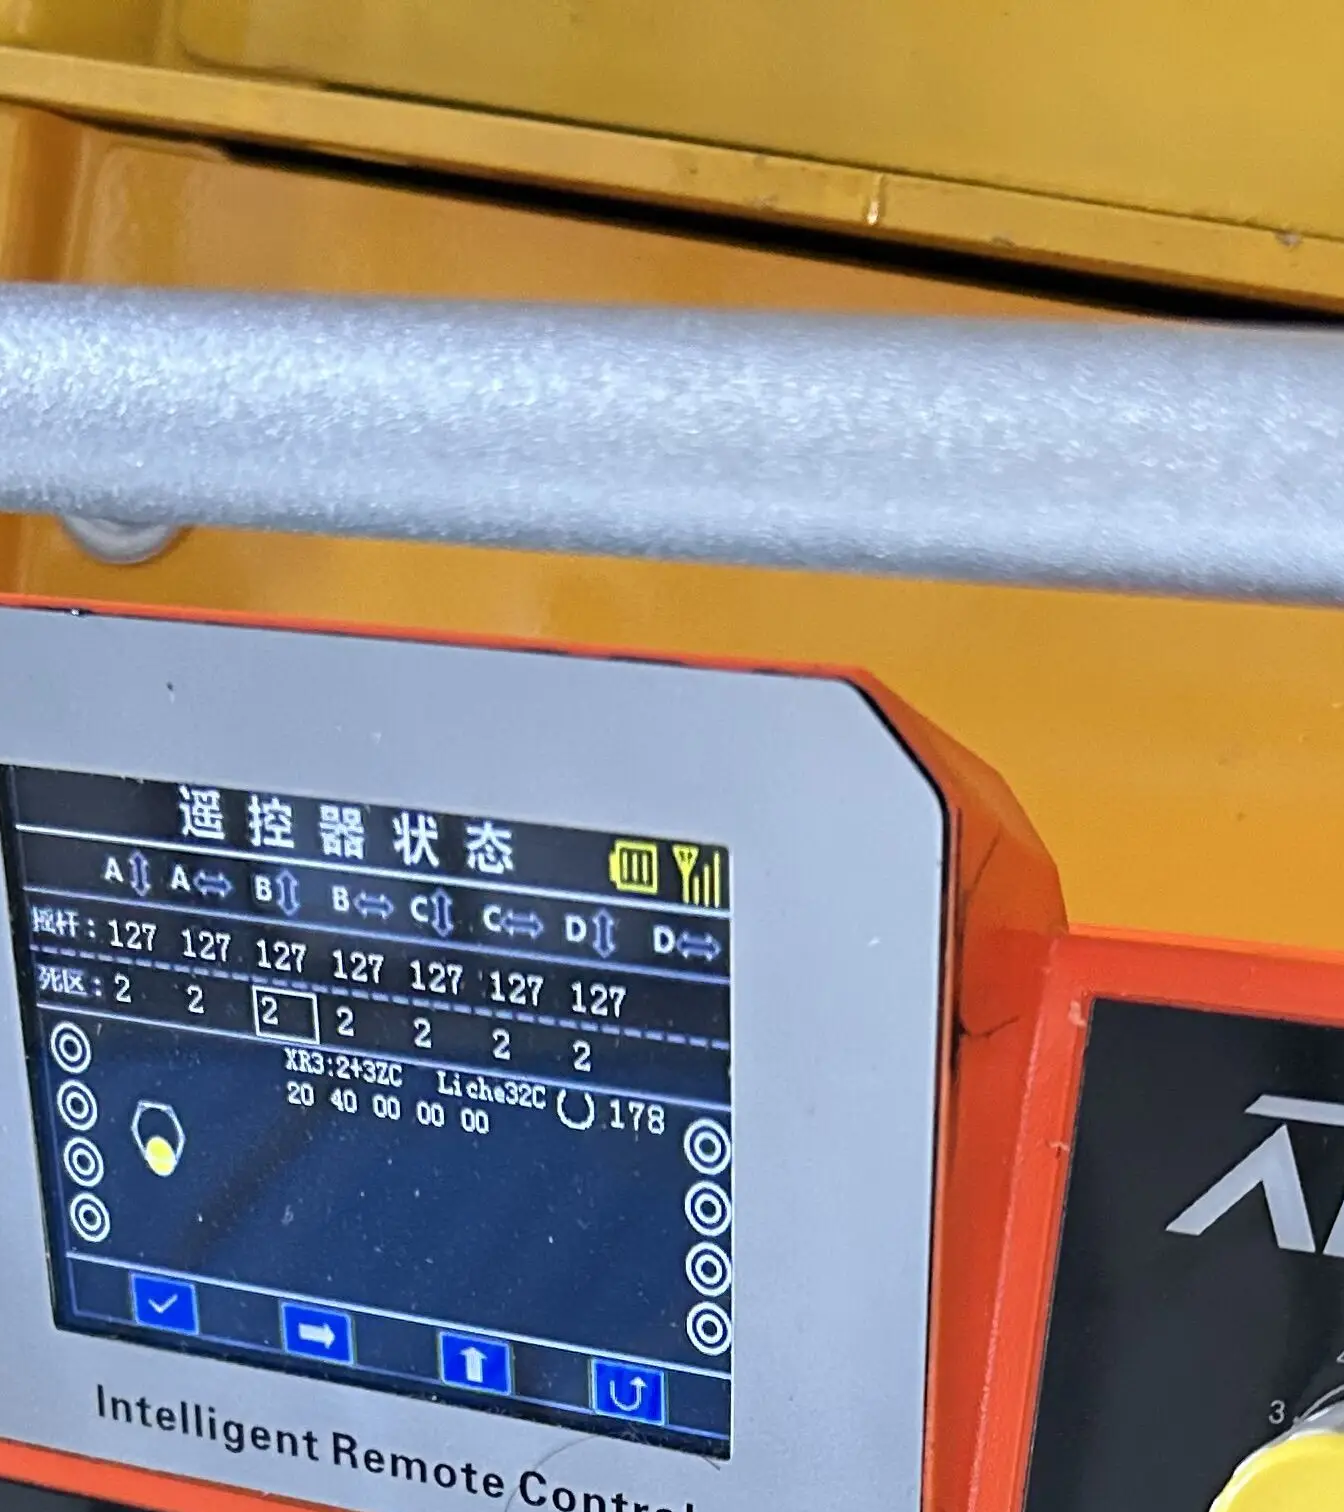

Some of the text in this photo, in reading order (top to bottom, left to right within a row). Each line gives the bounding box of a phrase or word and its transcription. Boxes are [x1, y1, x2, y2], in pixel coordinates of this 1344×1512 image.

[179, 785, 513, 875] 遥控器状态
[104, 857, 676, 954] A A B B C C D D
[108, 919, 157, 951] 127
[181, 928, 232, 962] 127
[256, 939, 307, 973] 127
[332, 949, 384, 984] 127
[410, 959, 464, 994] 127
[489, 970, 545, 1006] 127
[571, 980, 628, 1018] 127
[114, 974, 132, 1003] 2
[186, 985, 205, 1014] 2
[260, 996, 280, 1025] 2
[336, 1006, 355, 1037] 2
[413, 1017, 433, 1049] 2
[492, 1028, 512, 1060] 2
[573, 1039, 593, 1072] 2
[286, 1081, 316, 1107] 20
[330, 1088, 358, 1114] 40
[435, 1070, 548, 1110] Liche32C
[610, 1101, 666, 1135] 178
[96, 1384, 319, 1463] Intelligent
[332, 1431, 505, 1499] Remote
[1268, 1400, 1287, 1425] 3
